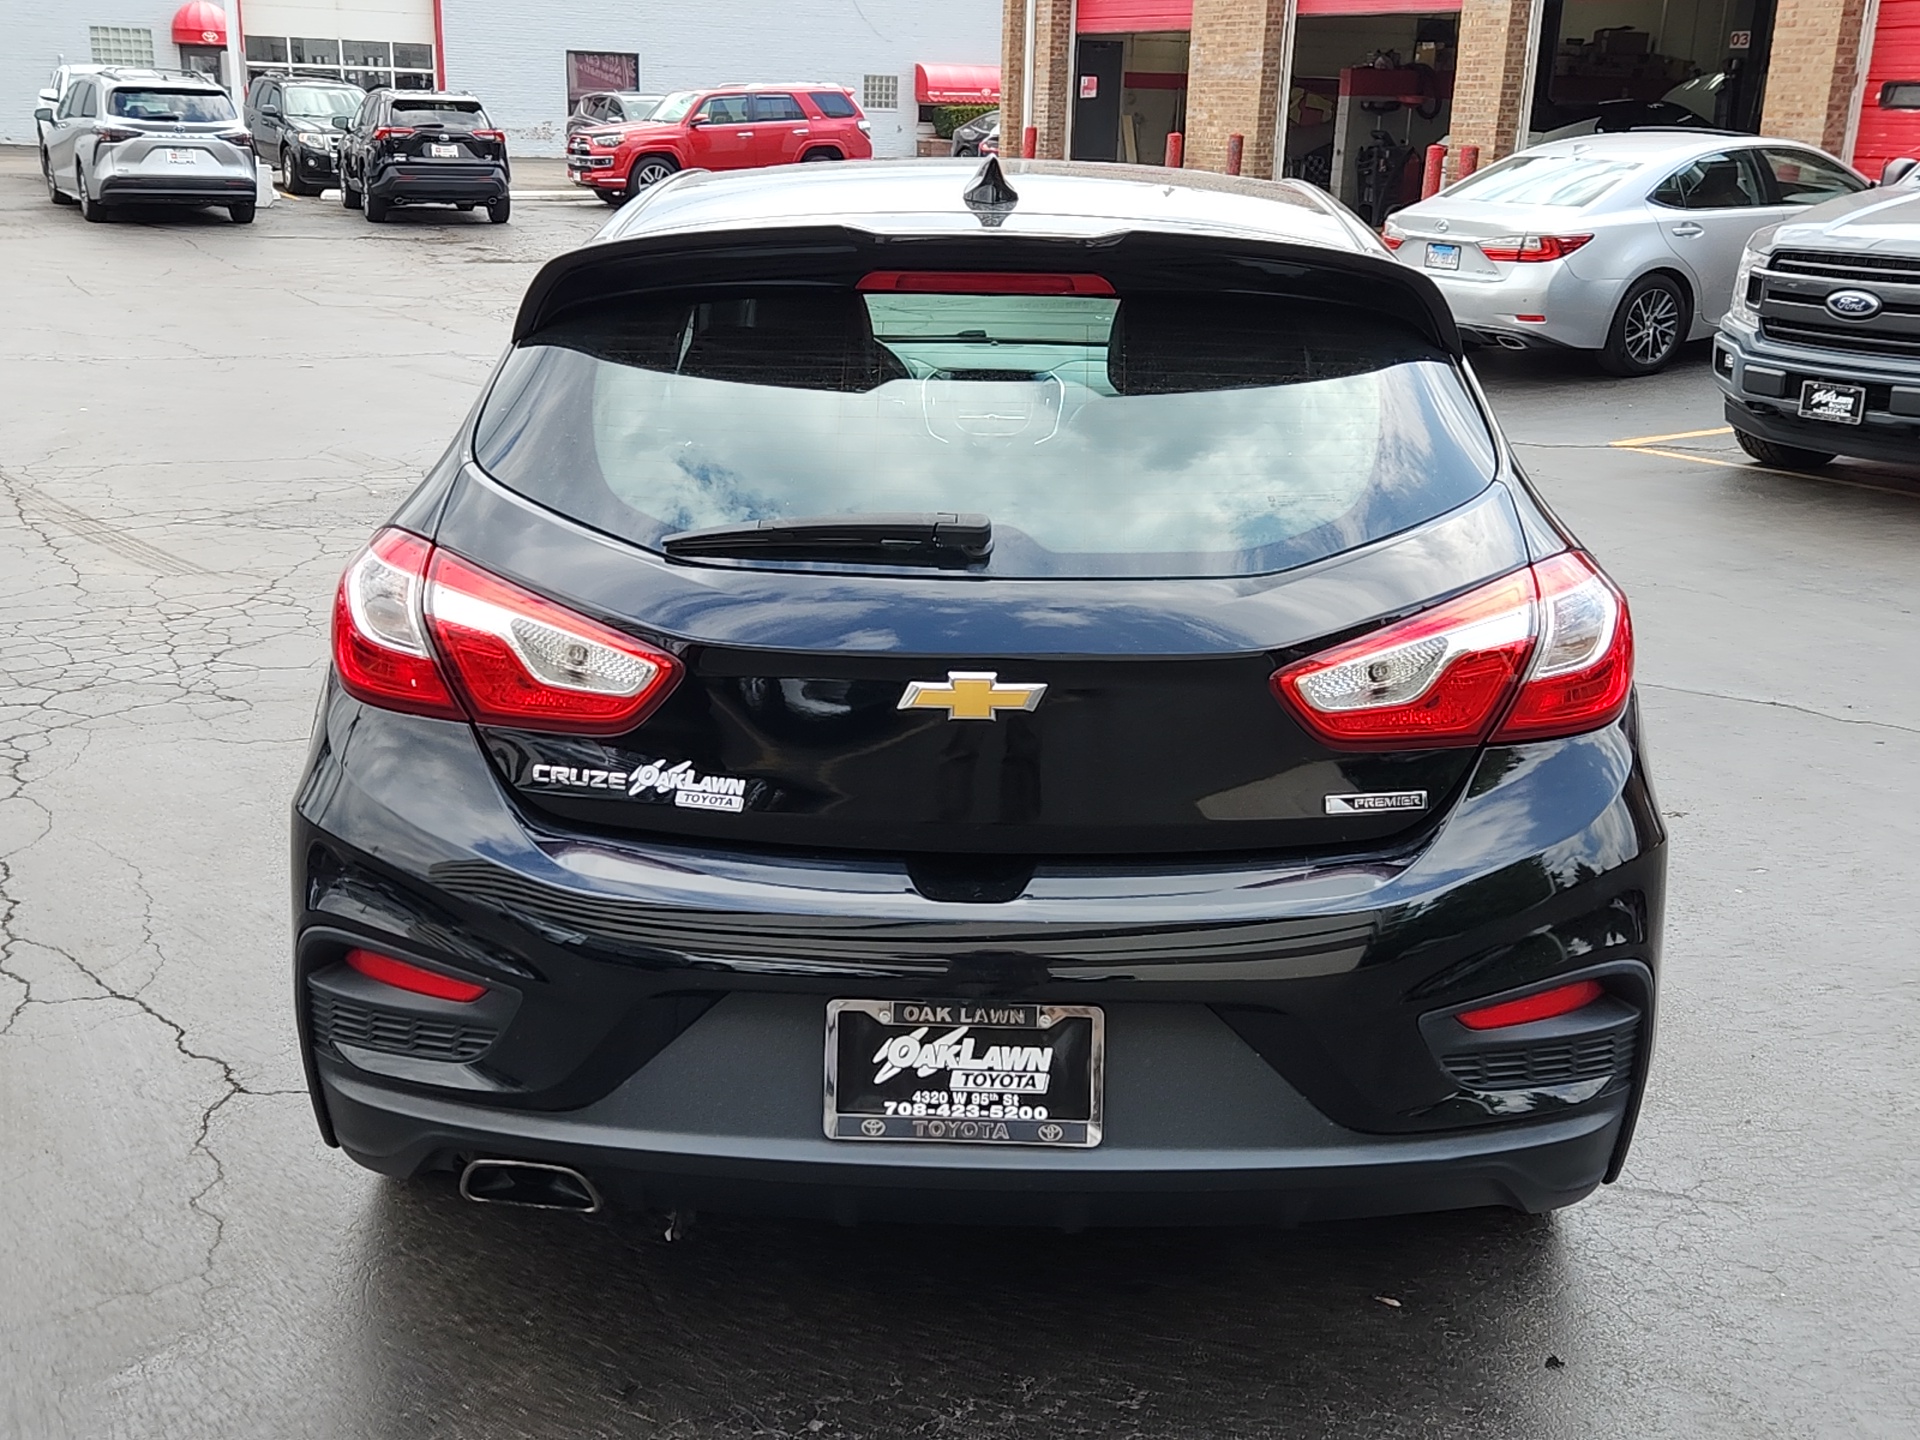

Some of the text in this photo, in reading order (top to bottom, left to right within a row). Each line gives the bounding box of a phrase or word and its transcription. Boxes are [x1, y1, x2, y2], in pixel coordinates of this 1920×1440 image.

[1732, 33, 1749, 46] 03
[1837, 296, 1866, 311] Ford
[532, 764, 627, 789] CRUZE
[684, 793, 734, 807] TOYOTA
[1354, 795, 1421, 809] PREMIER
[903, 1005, 1026, 1024] OAK LAWN
[961, 1072, 1039, 1089] TOYOTA
[912, 1090, 1020, 1107] 4320 W 95th St
[883, 1101, 1048, 1121] 708-423-5200
[912, 1120, 1010, 1140] TOYOTA
